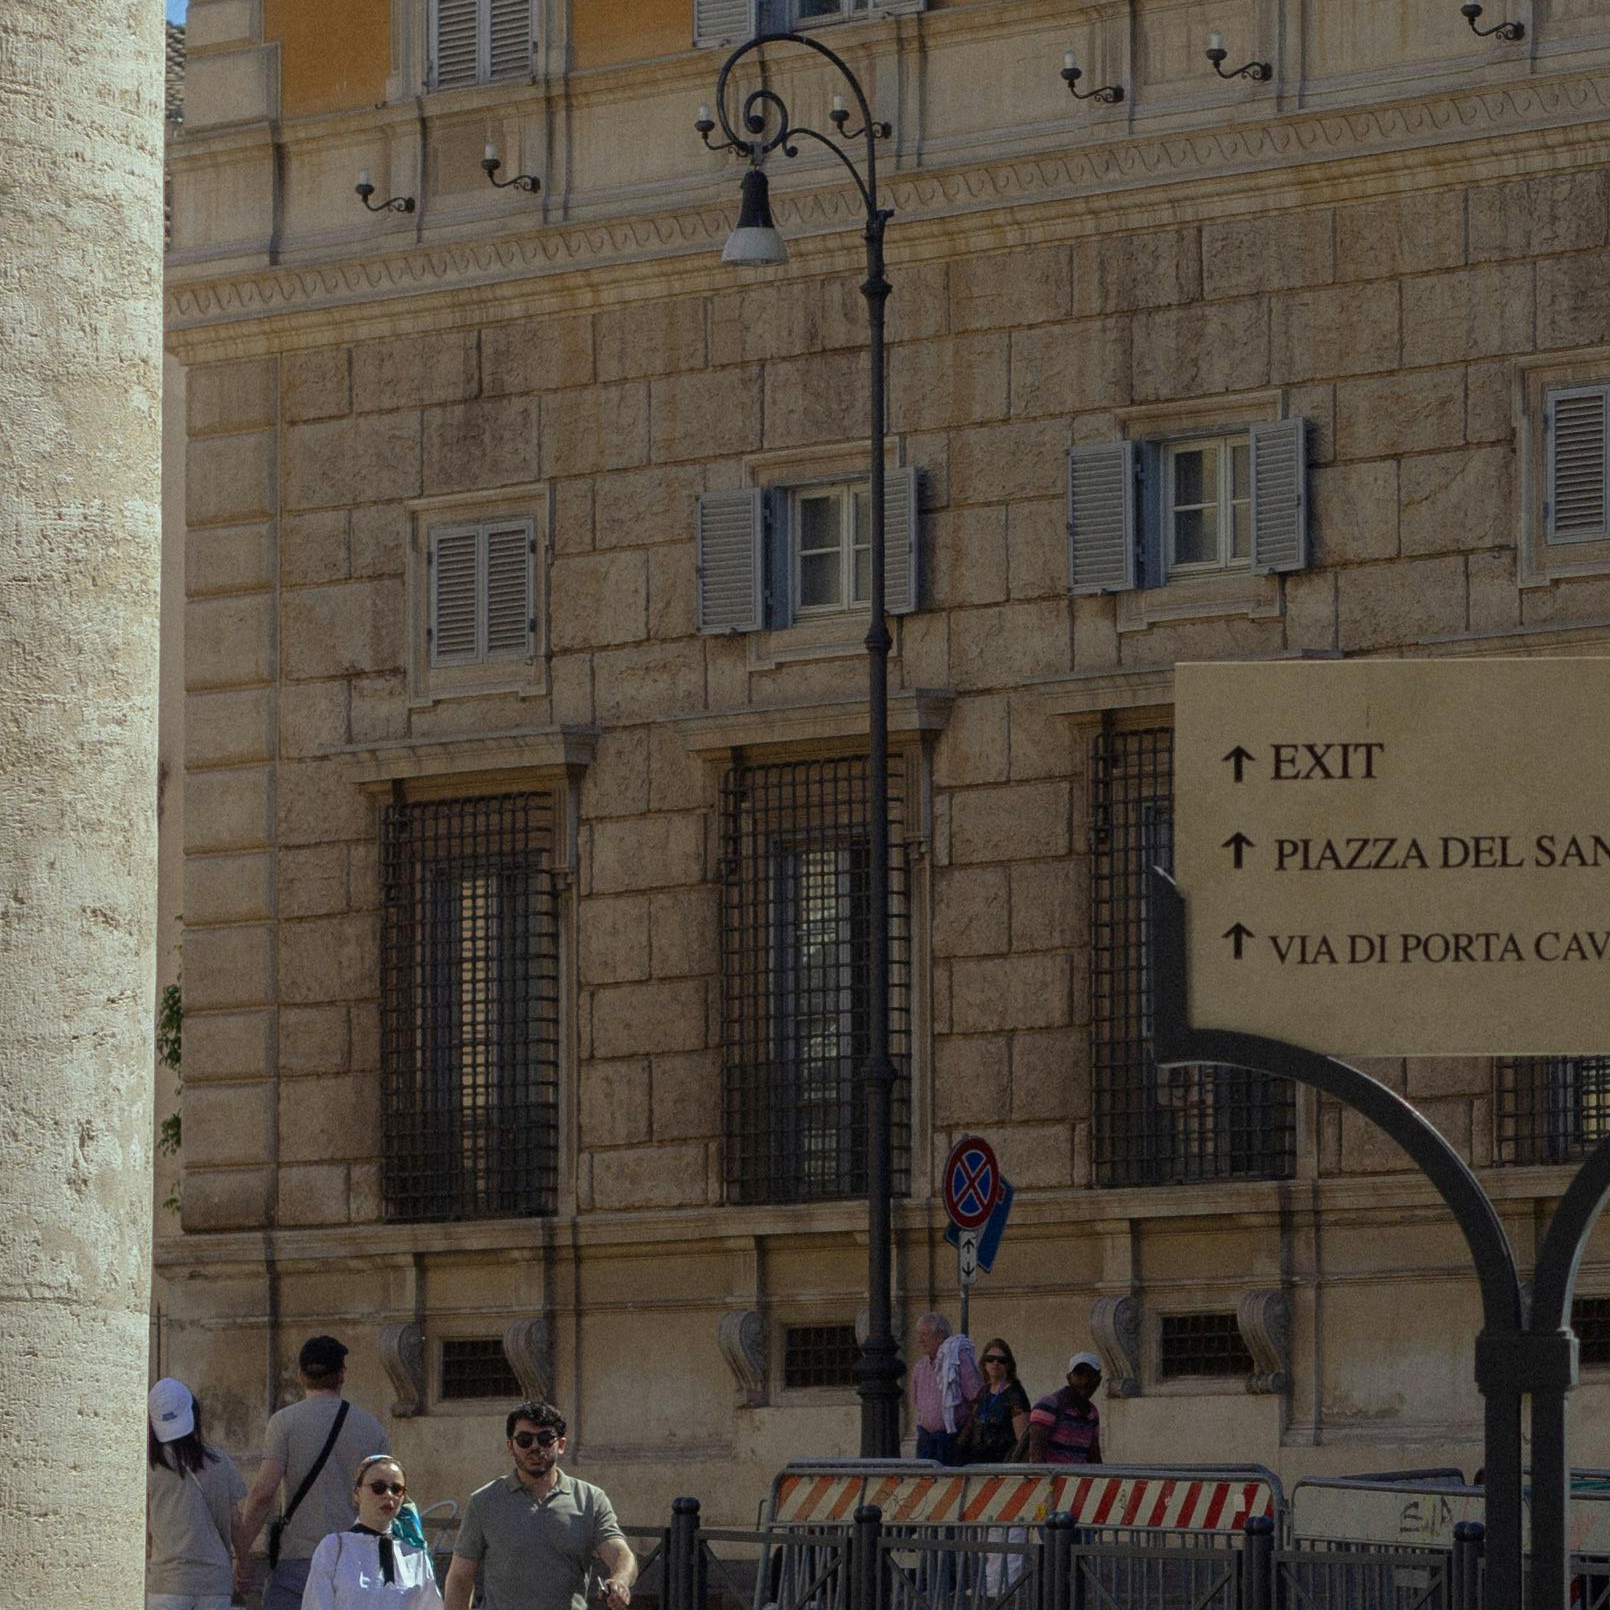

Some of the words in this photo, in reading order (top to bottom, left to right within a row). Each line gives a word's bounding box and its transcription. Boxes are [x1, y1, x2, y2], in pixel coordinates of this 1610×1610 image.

[1271, 742, 1385, 781] EXIT
[1275, 837, 1429, 871] PIAZZA
[1440, 835, 1525, 869] DEL
[1268, 935, 1338, 965] VIA
[1348, 933, 1387, 964] DI
[1400, 932, 1525, 964] PORTA
